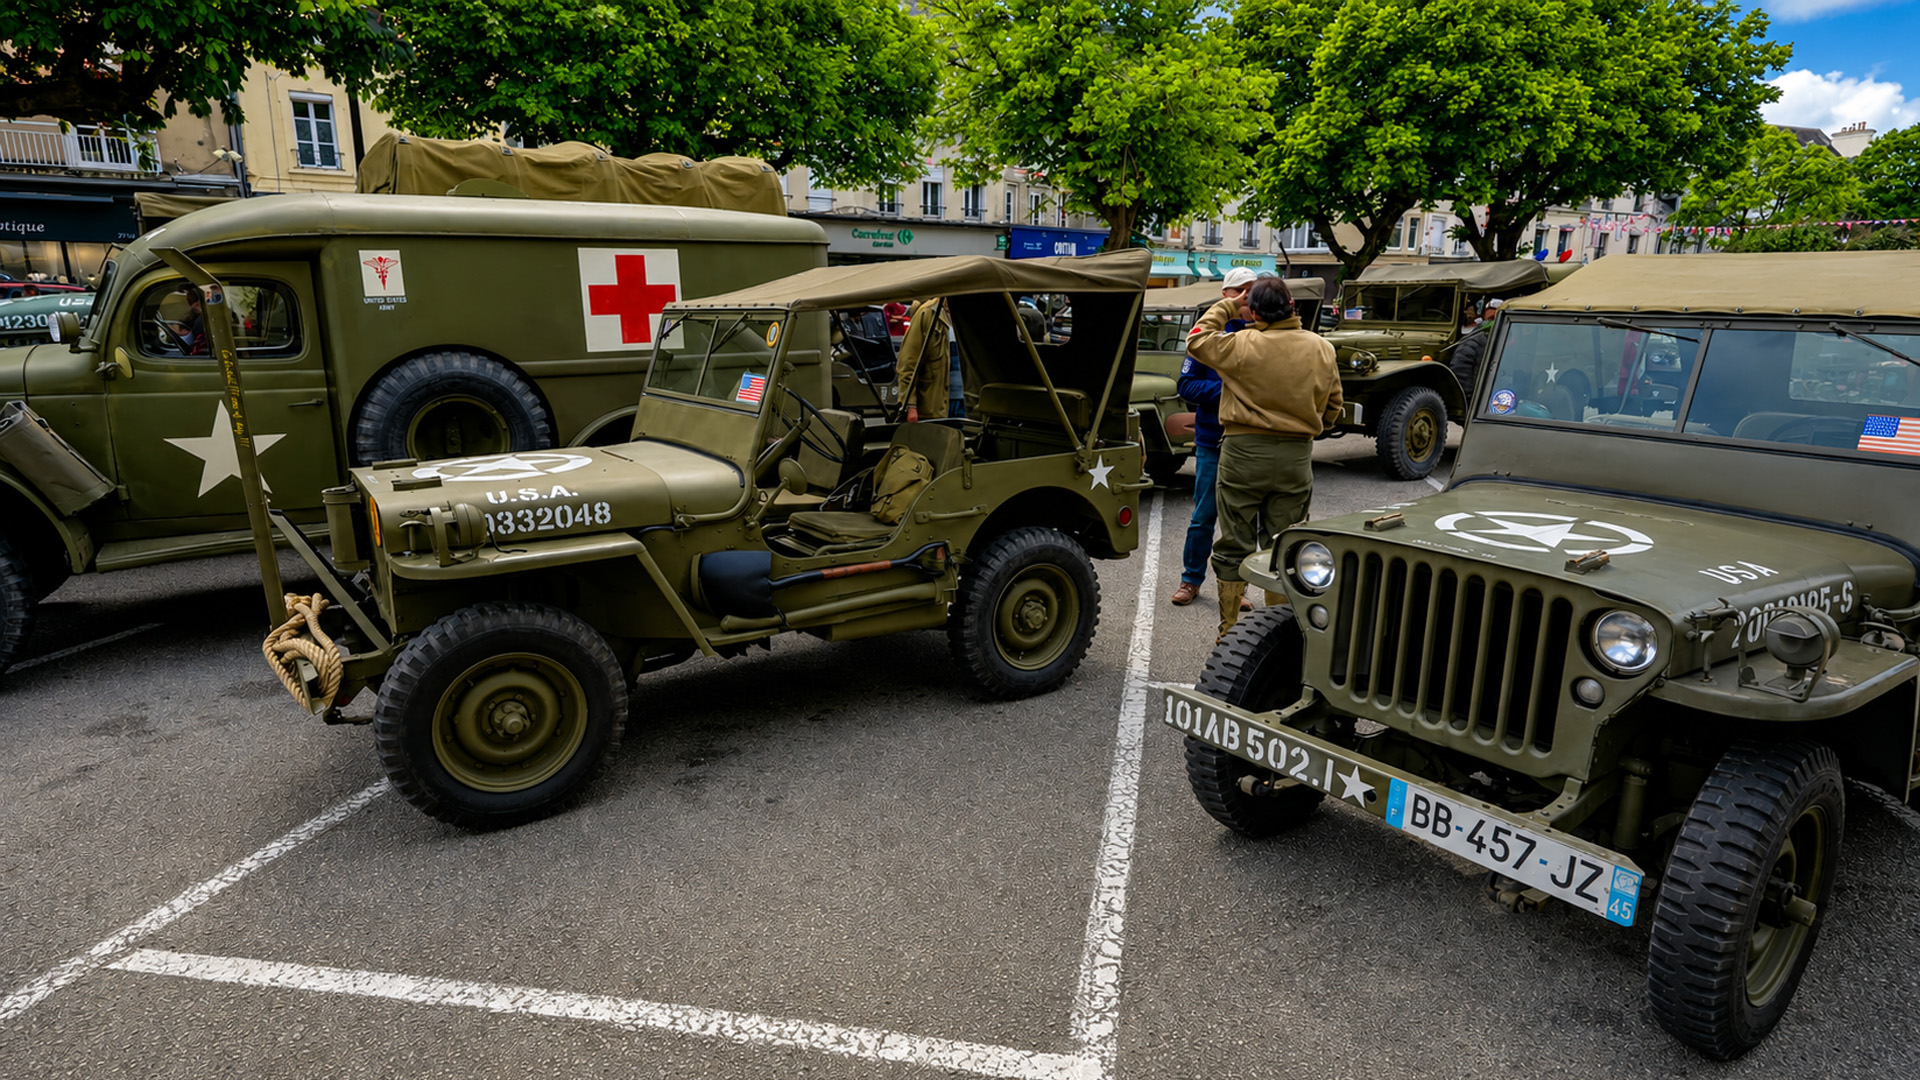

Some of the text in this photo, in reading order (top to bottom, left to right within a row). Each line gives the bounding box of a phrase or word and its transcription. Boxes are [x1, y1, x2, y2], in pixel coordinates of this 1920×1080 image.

[485, 485, 579, 504] U.S.A.
[1698, 560, 1779, 585] USA
[1410, 793, 1605, 904] BB-457-JZ
[1609, 898, 1633, 920] 45
